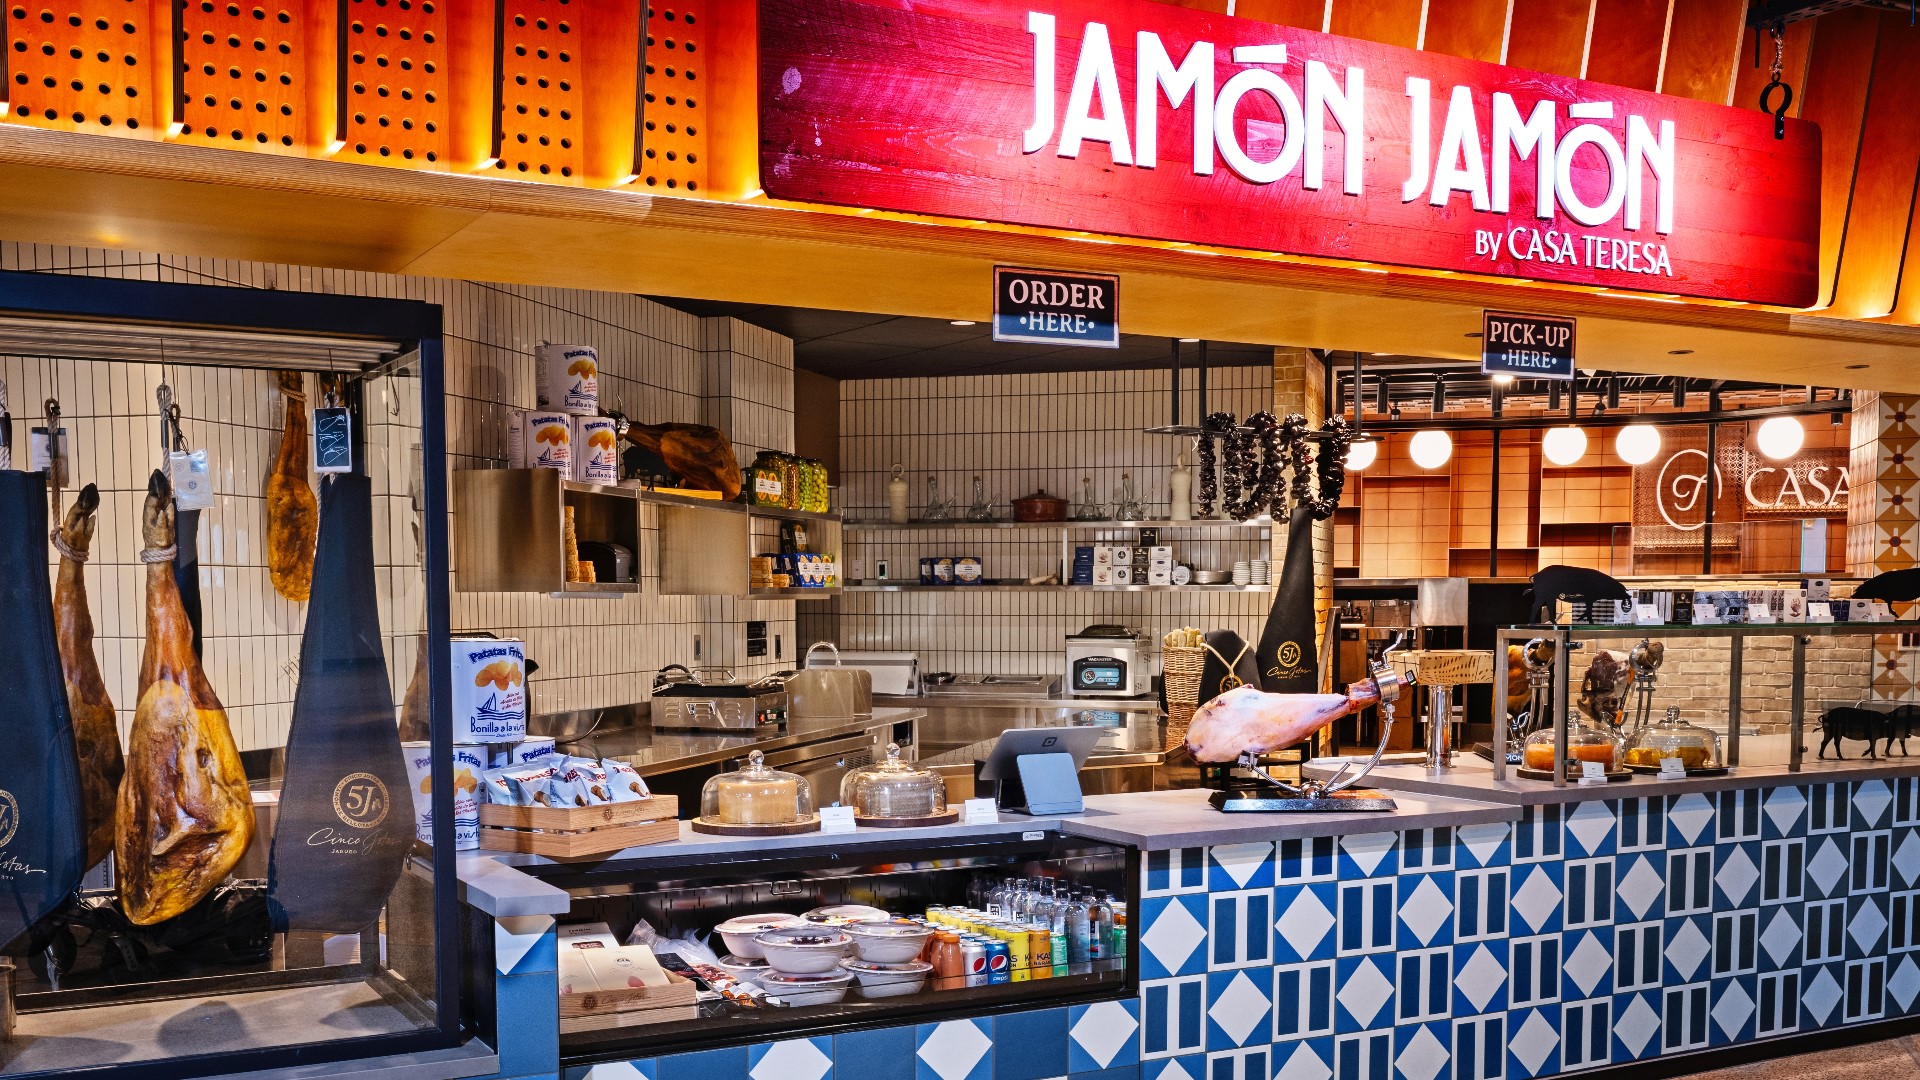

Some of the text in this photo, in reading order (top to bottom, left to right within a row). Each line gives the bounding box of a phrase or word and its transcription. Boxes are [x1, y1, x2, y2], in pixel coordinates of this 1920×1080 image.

[1507, 227, 1578, 266] CASA
[1582, 234, 1673, 277] TERESA
[1008, 279, 1105, 310] ORDER
[1489, 321, 1570, 348] PICK-UP
[563, 350, 589, 360] Patatas
[531, 416, 558, 427] Patatas
[1744, 466, 1850, 508] CASA
[468, 647, 507, 664] Patatas
[470, 716, 498, 733] Bonilla
[500, 725, 506, 733] a
[507, 722, 513, 732] la
[458, 751, 482, 768] Fritas
[346, 785, 377, 817] 5J
[306, 827, 361, 846] Cinco
